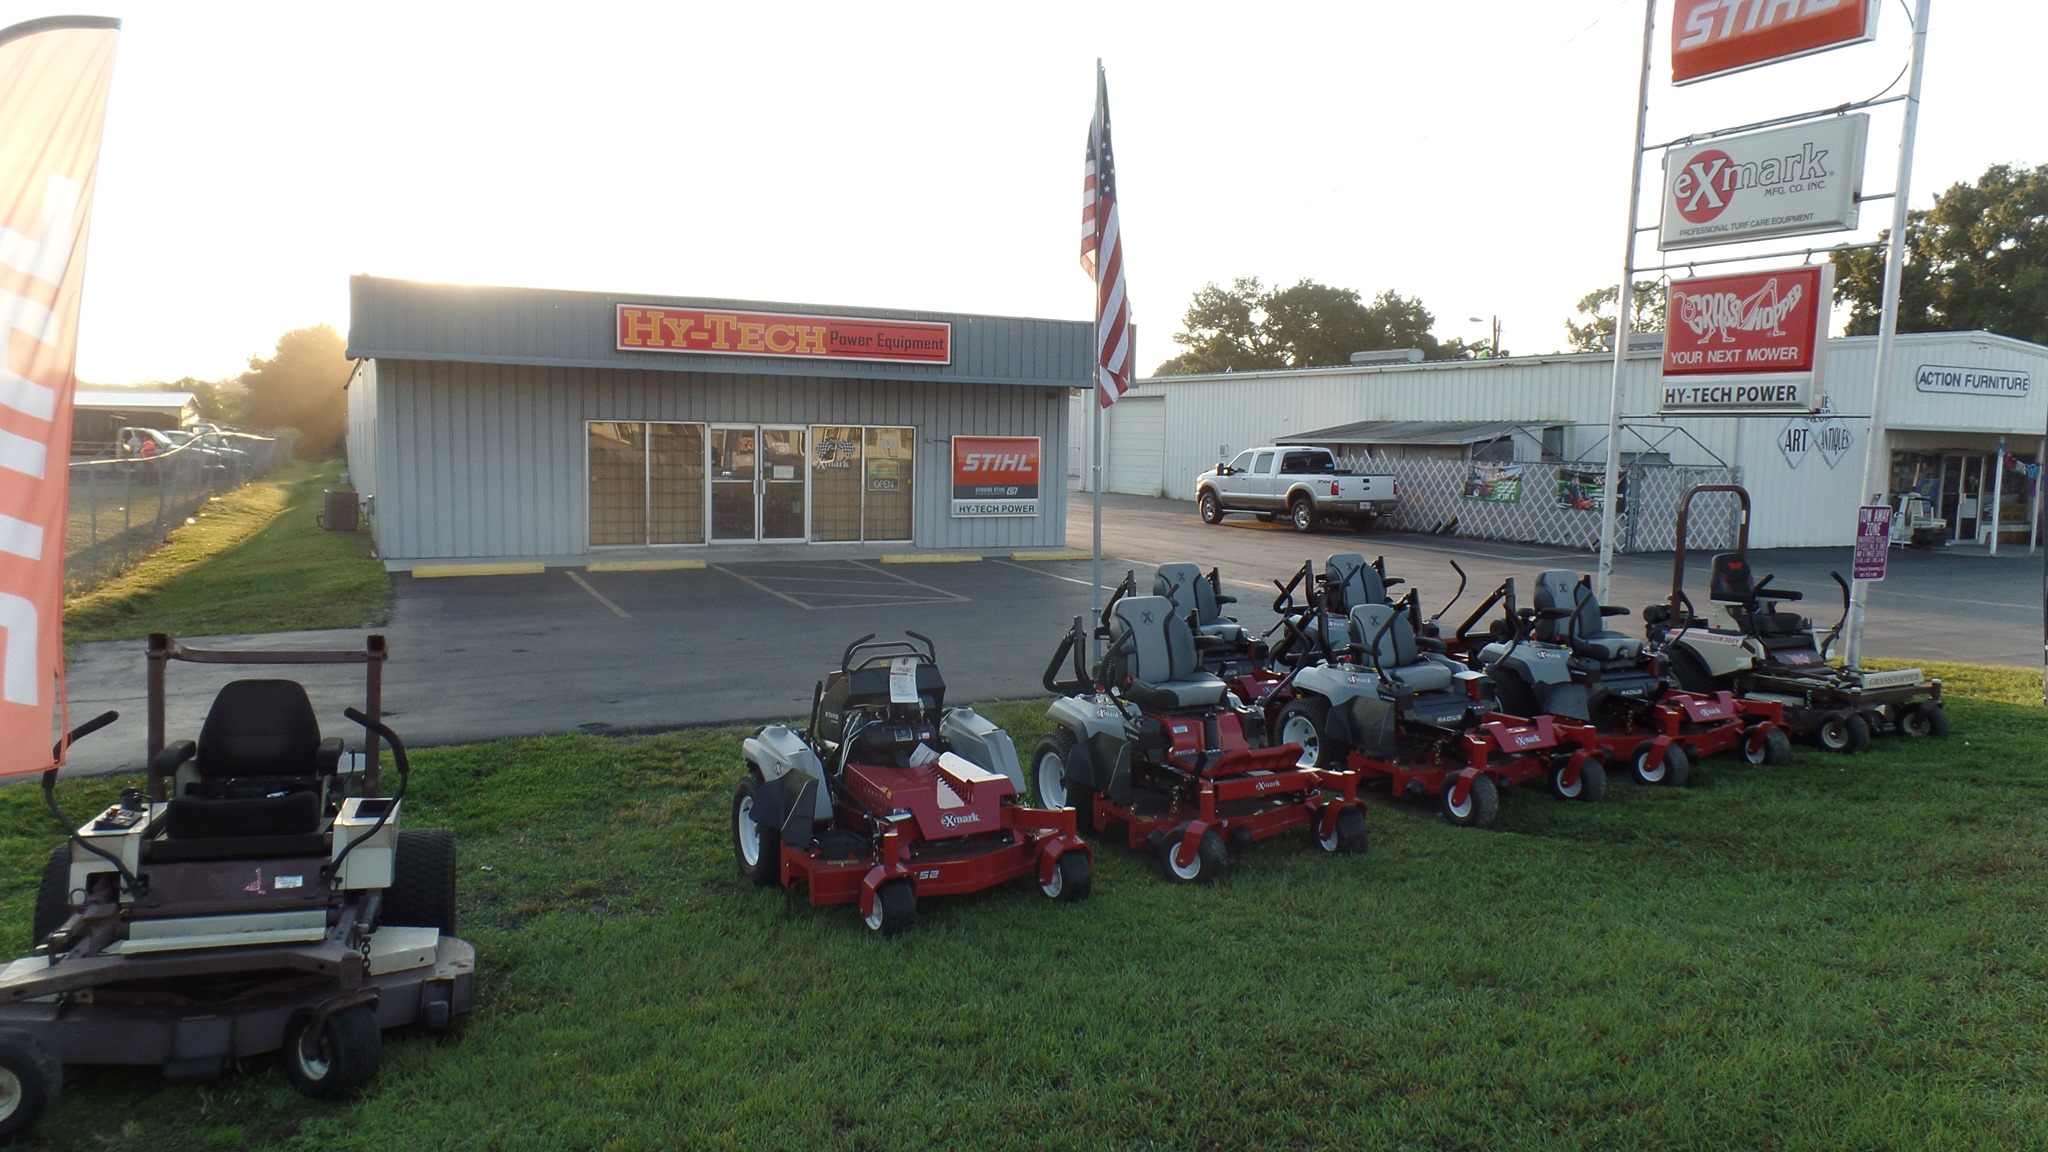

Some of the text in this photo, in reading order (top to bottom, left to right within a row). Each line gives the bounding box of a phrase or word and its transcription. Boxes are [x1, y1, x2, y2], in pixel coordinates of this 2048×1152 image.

[1764, 181, 1827, 197] MFG. CO. INC.
[1679, 212, 1815, 237] PROFESSIONAL TURF CARE EQUIPMENT
[830, 330, 871, 347] Power
[876, 332, 945, 352] Equipment
[1671, 346, 1798, 364] YOUR NEXT MOWER
[1919, 371, 2029, 391] ACTION FURNITURE
[1665, 385, 1797, 403] HY-TECH POWER
[1785, 428, 1809, 452] ART
[962, 453, 1033, 471] STIHL
[873, 480, 894, 488] OPEN
[959, 505, 1035, 513] HY-TECH POWER
[1865, 522, 1881, 536] ZONE
[1869, 673, 1920, 685] GRASSHOPPER
[1621, 688, 1643, 696] RADIUS
[1437, 714, 1462, 723] RADIUS
